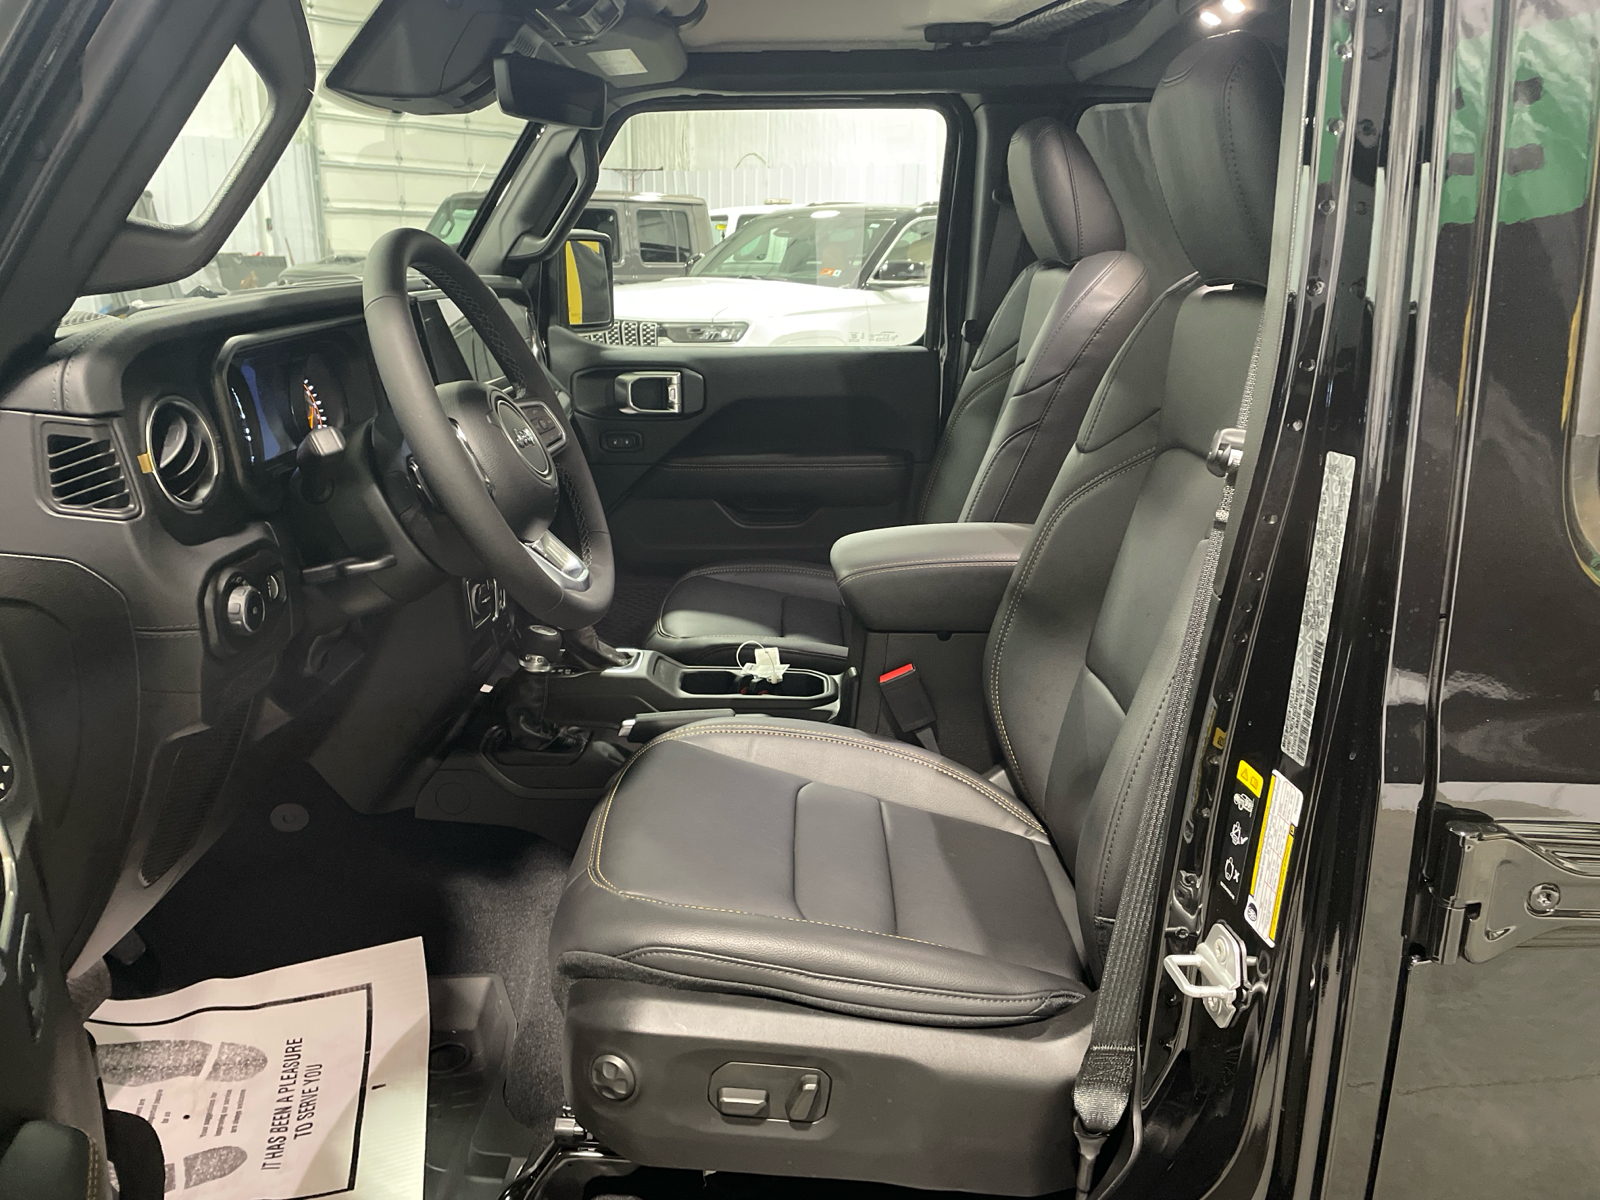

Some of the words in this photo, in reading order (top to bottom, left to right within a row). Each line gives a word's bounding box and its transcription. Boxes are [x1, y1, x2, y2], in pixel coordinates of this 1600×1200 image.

[278, 1037, 303, 1094] PLEASURE
[303, 1064, 323, 1086] YOU
[276, 1095, 294, 1103] A
[297, 1086, 319, 1121] SERVE
[269, 1105, 292, 1133] BEEN
[293, 1122, 313, 1140] TO
[264, 1136, 287, 1160] HAS
[261, 1162, 281, 1170] IT
